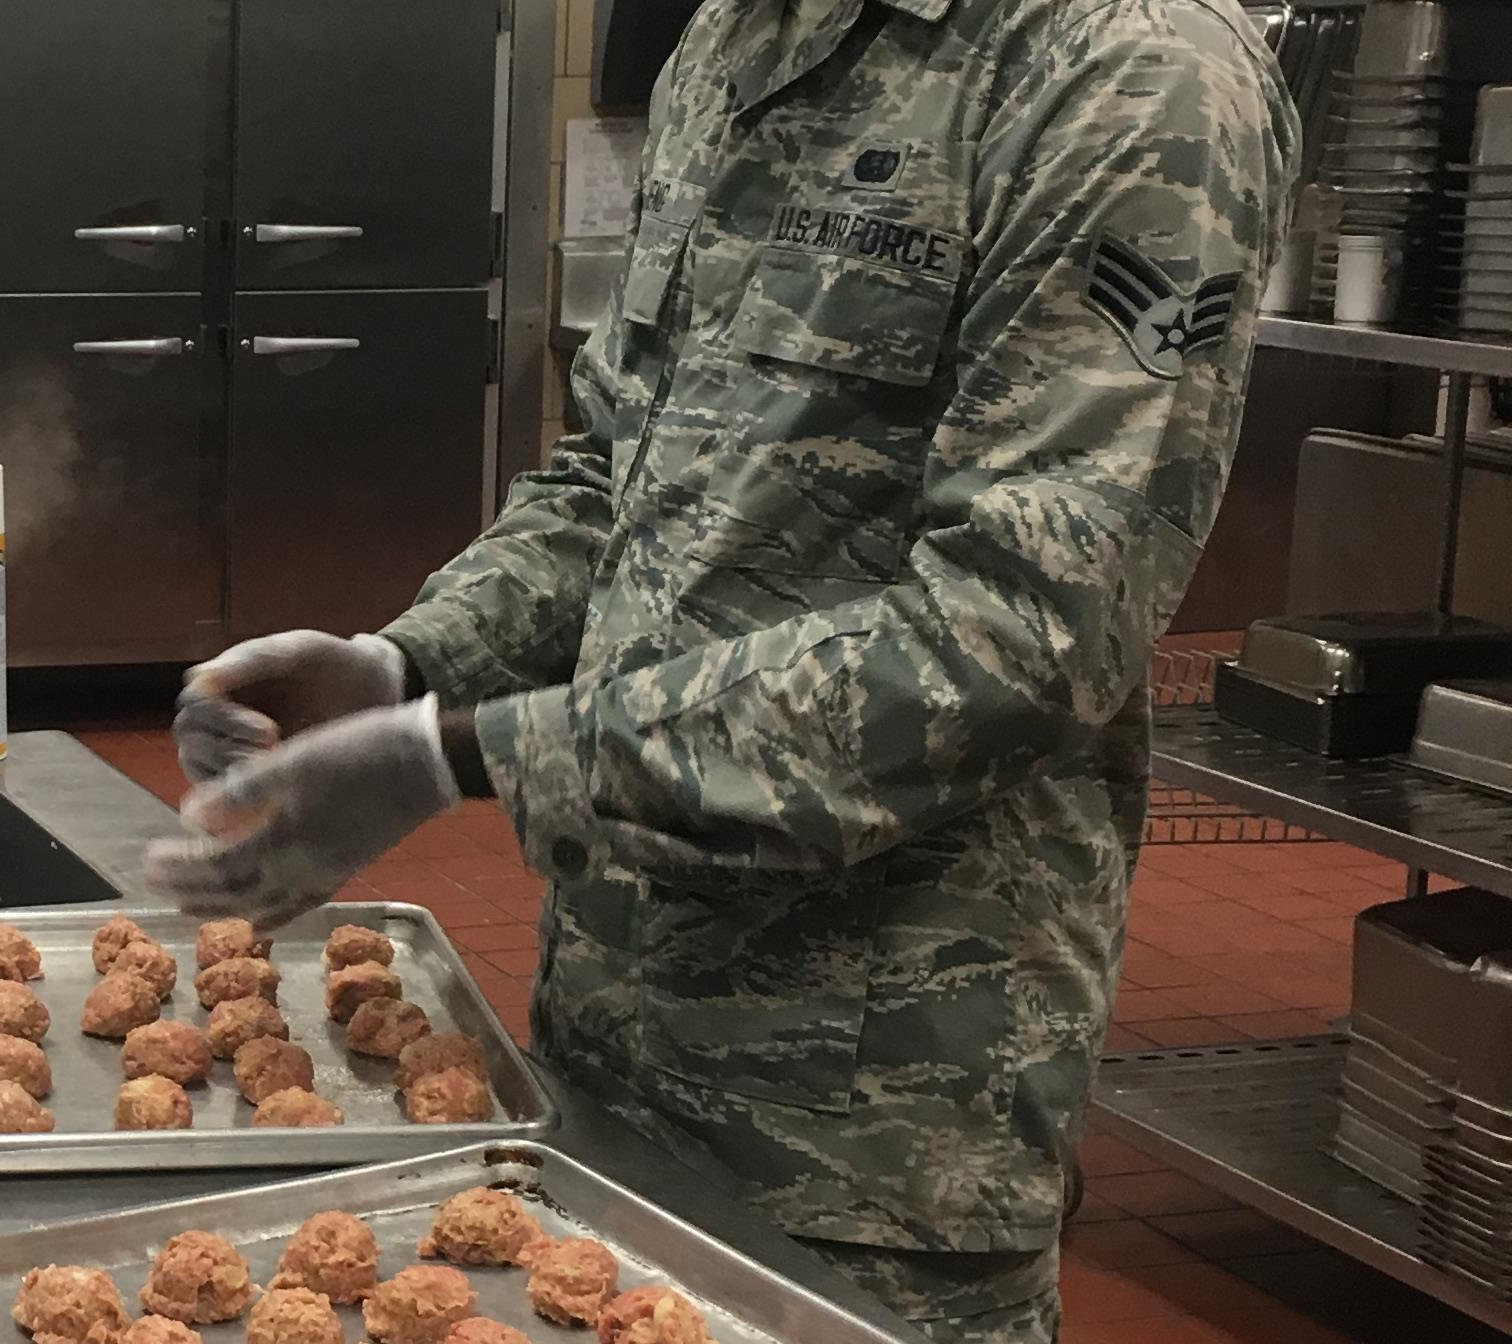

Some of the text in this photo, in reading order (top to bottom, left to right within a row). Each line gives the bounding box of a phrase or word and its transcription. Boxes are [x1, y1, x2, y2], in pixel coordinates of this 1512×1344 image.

[775, 205, 950, 271] U.S. AIR FORCE
